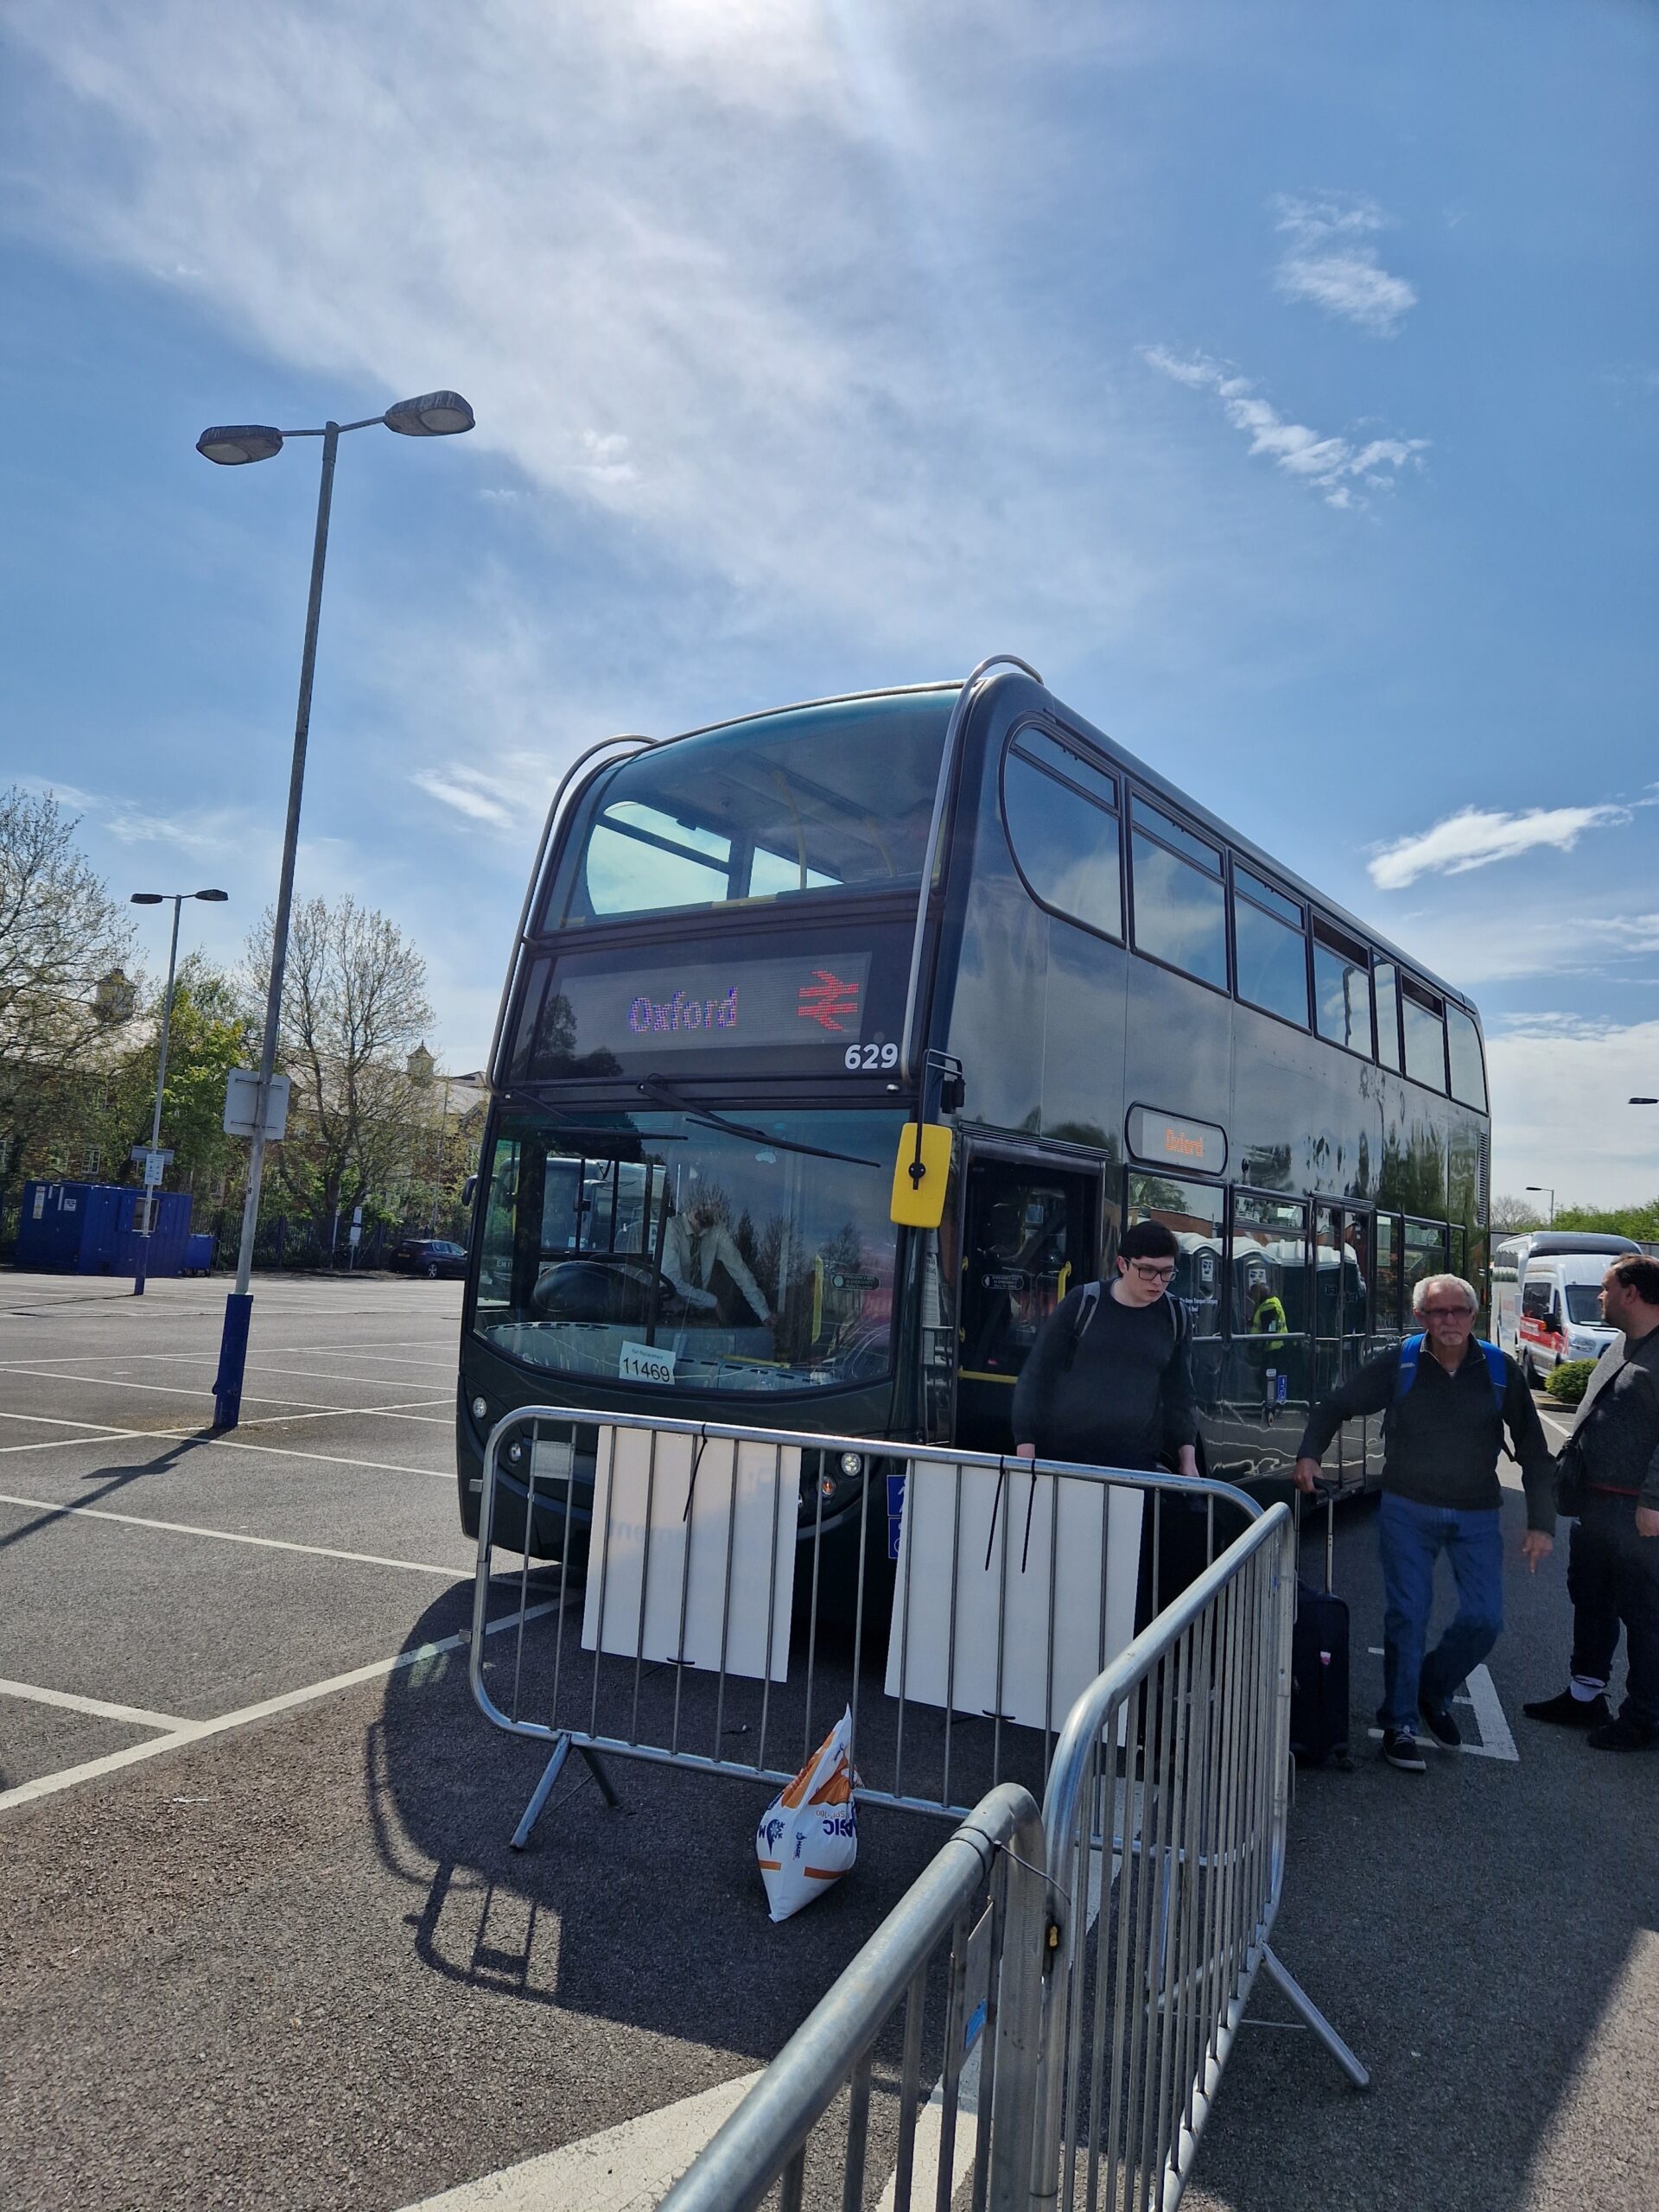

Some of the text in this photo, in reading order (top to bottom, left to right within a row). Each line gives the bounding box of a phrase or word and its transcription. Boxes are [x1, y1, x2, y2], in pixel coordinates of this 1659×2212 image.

[628, 986, 738, 1033] Oxford
[843, 1043, 899, 1070] 629
[1165, 1128, 1203, 1158] Oxford
[623, 1357, 671, 1382] 11469
[823, 1818, 853, 1838] AGIC
